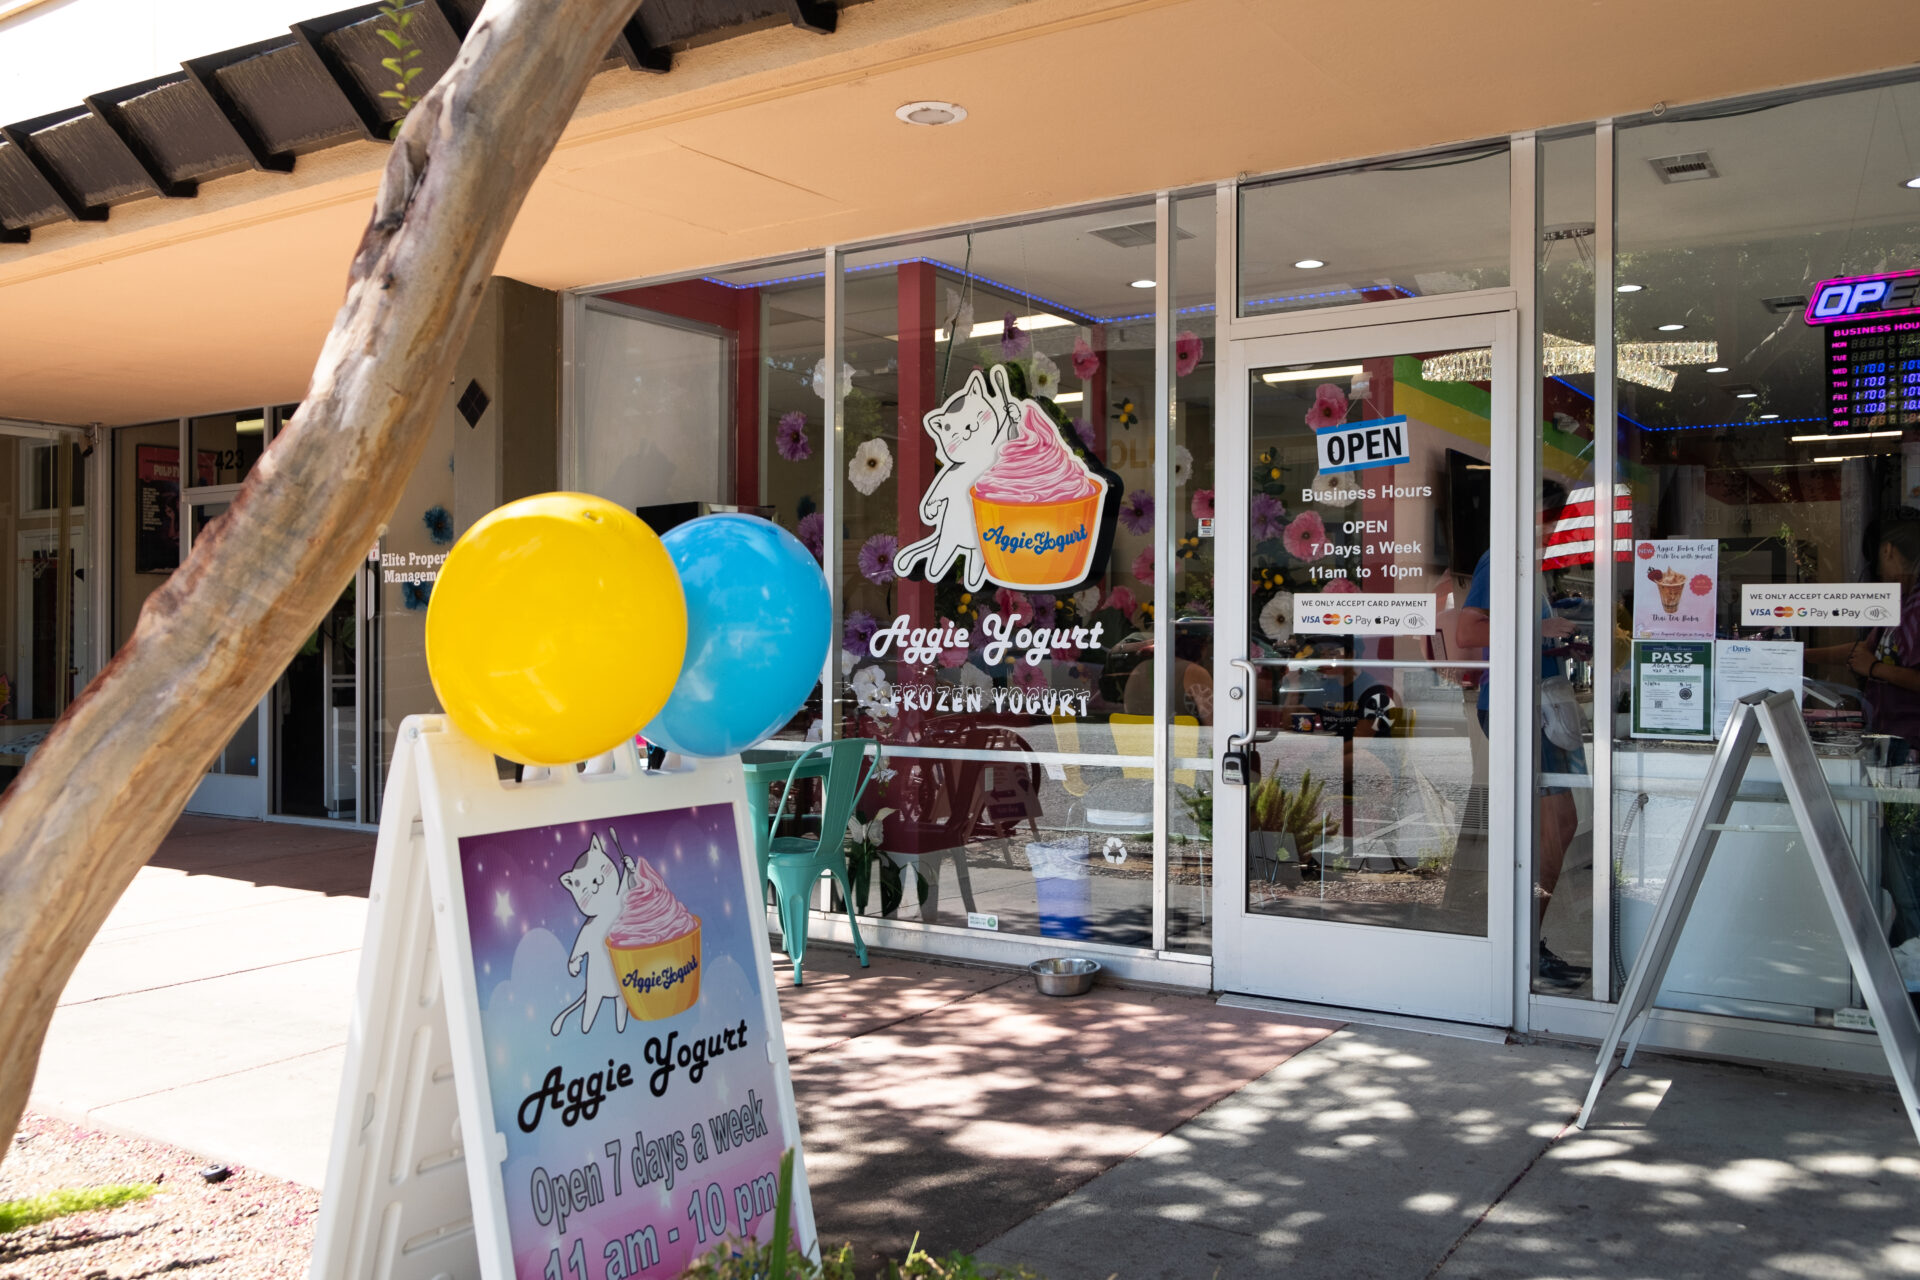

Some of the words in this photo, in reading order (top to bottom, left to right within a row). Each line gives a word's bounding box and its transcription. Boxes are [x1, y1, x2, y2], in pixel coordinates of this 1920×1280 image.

[1815, 276, 1920, 317] OPE
[1833, 324, 1891, 337] BUSINESS
[1894, 322, 1920, 331] HOU
[1832, 367, 1848, 375] WED
[1327, 426, 1402, 465] OPEN
[215, 450, 244, 470] 423
[1302, 487, 1376, 502] Business
[1381, 485, 1432, 499] Hours
[1343, 520, 1388, 534] OPEN
[1311, 543, 1320, 556] 7
[1324, 542, 1361, 558] Days
[1365, 544, 1375, 555] a
[1379, 541, 1422, 554] Week
[382, 552, 406, 567] Elite
[409, 551, 449, 568] Proper
[384, 570, 436, 586] Managem
[1308, 566, 1347, 579] 11am
[1356, 566, 1371, 578] to
[1381, 564, 1423, 580] 10pm
[1301, 615, 1320, 623] VISA
[1355, 616, 1372, 627] Pay
[1383, 616, 1400, 626] Pay
[1750, 608, 1771, 616] VISA
[1810, 608, 1828, 619] Pay
[1841, 608, 1860, 619] Pay
[869, 614, 969, 664] Aggie
[982, 613, 1104, 666] Yogurt
[1652, 652, 1693, 663] PASS
[1732, 645, 1751, 653] Davis
[890, 684, 982, 713] FROZEN
[991, 686, 1091, 717] YOGURT
[517, 1059, 633, 1133] Aggie
[644, 1019, 748, 1097] Yogurt
[530, 1162, 605, 1234] Open
[605, 1139, 622, 1196] 7
[631, 1131, 688, 1190] days
[691, 1122, 709, 1164] a
[708, 1089, 768, 1154] week
[544, 1238, 588, 1280] 11
[603, 1225, 660, 1280] am
[667, 1227, 680, 1245] -
[688, 1182, 727, 1243] 10
[734, 1171, 779, 1238] pm
